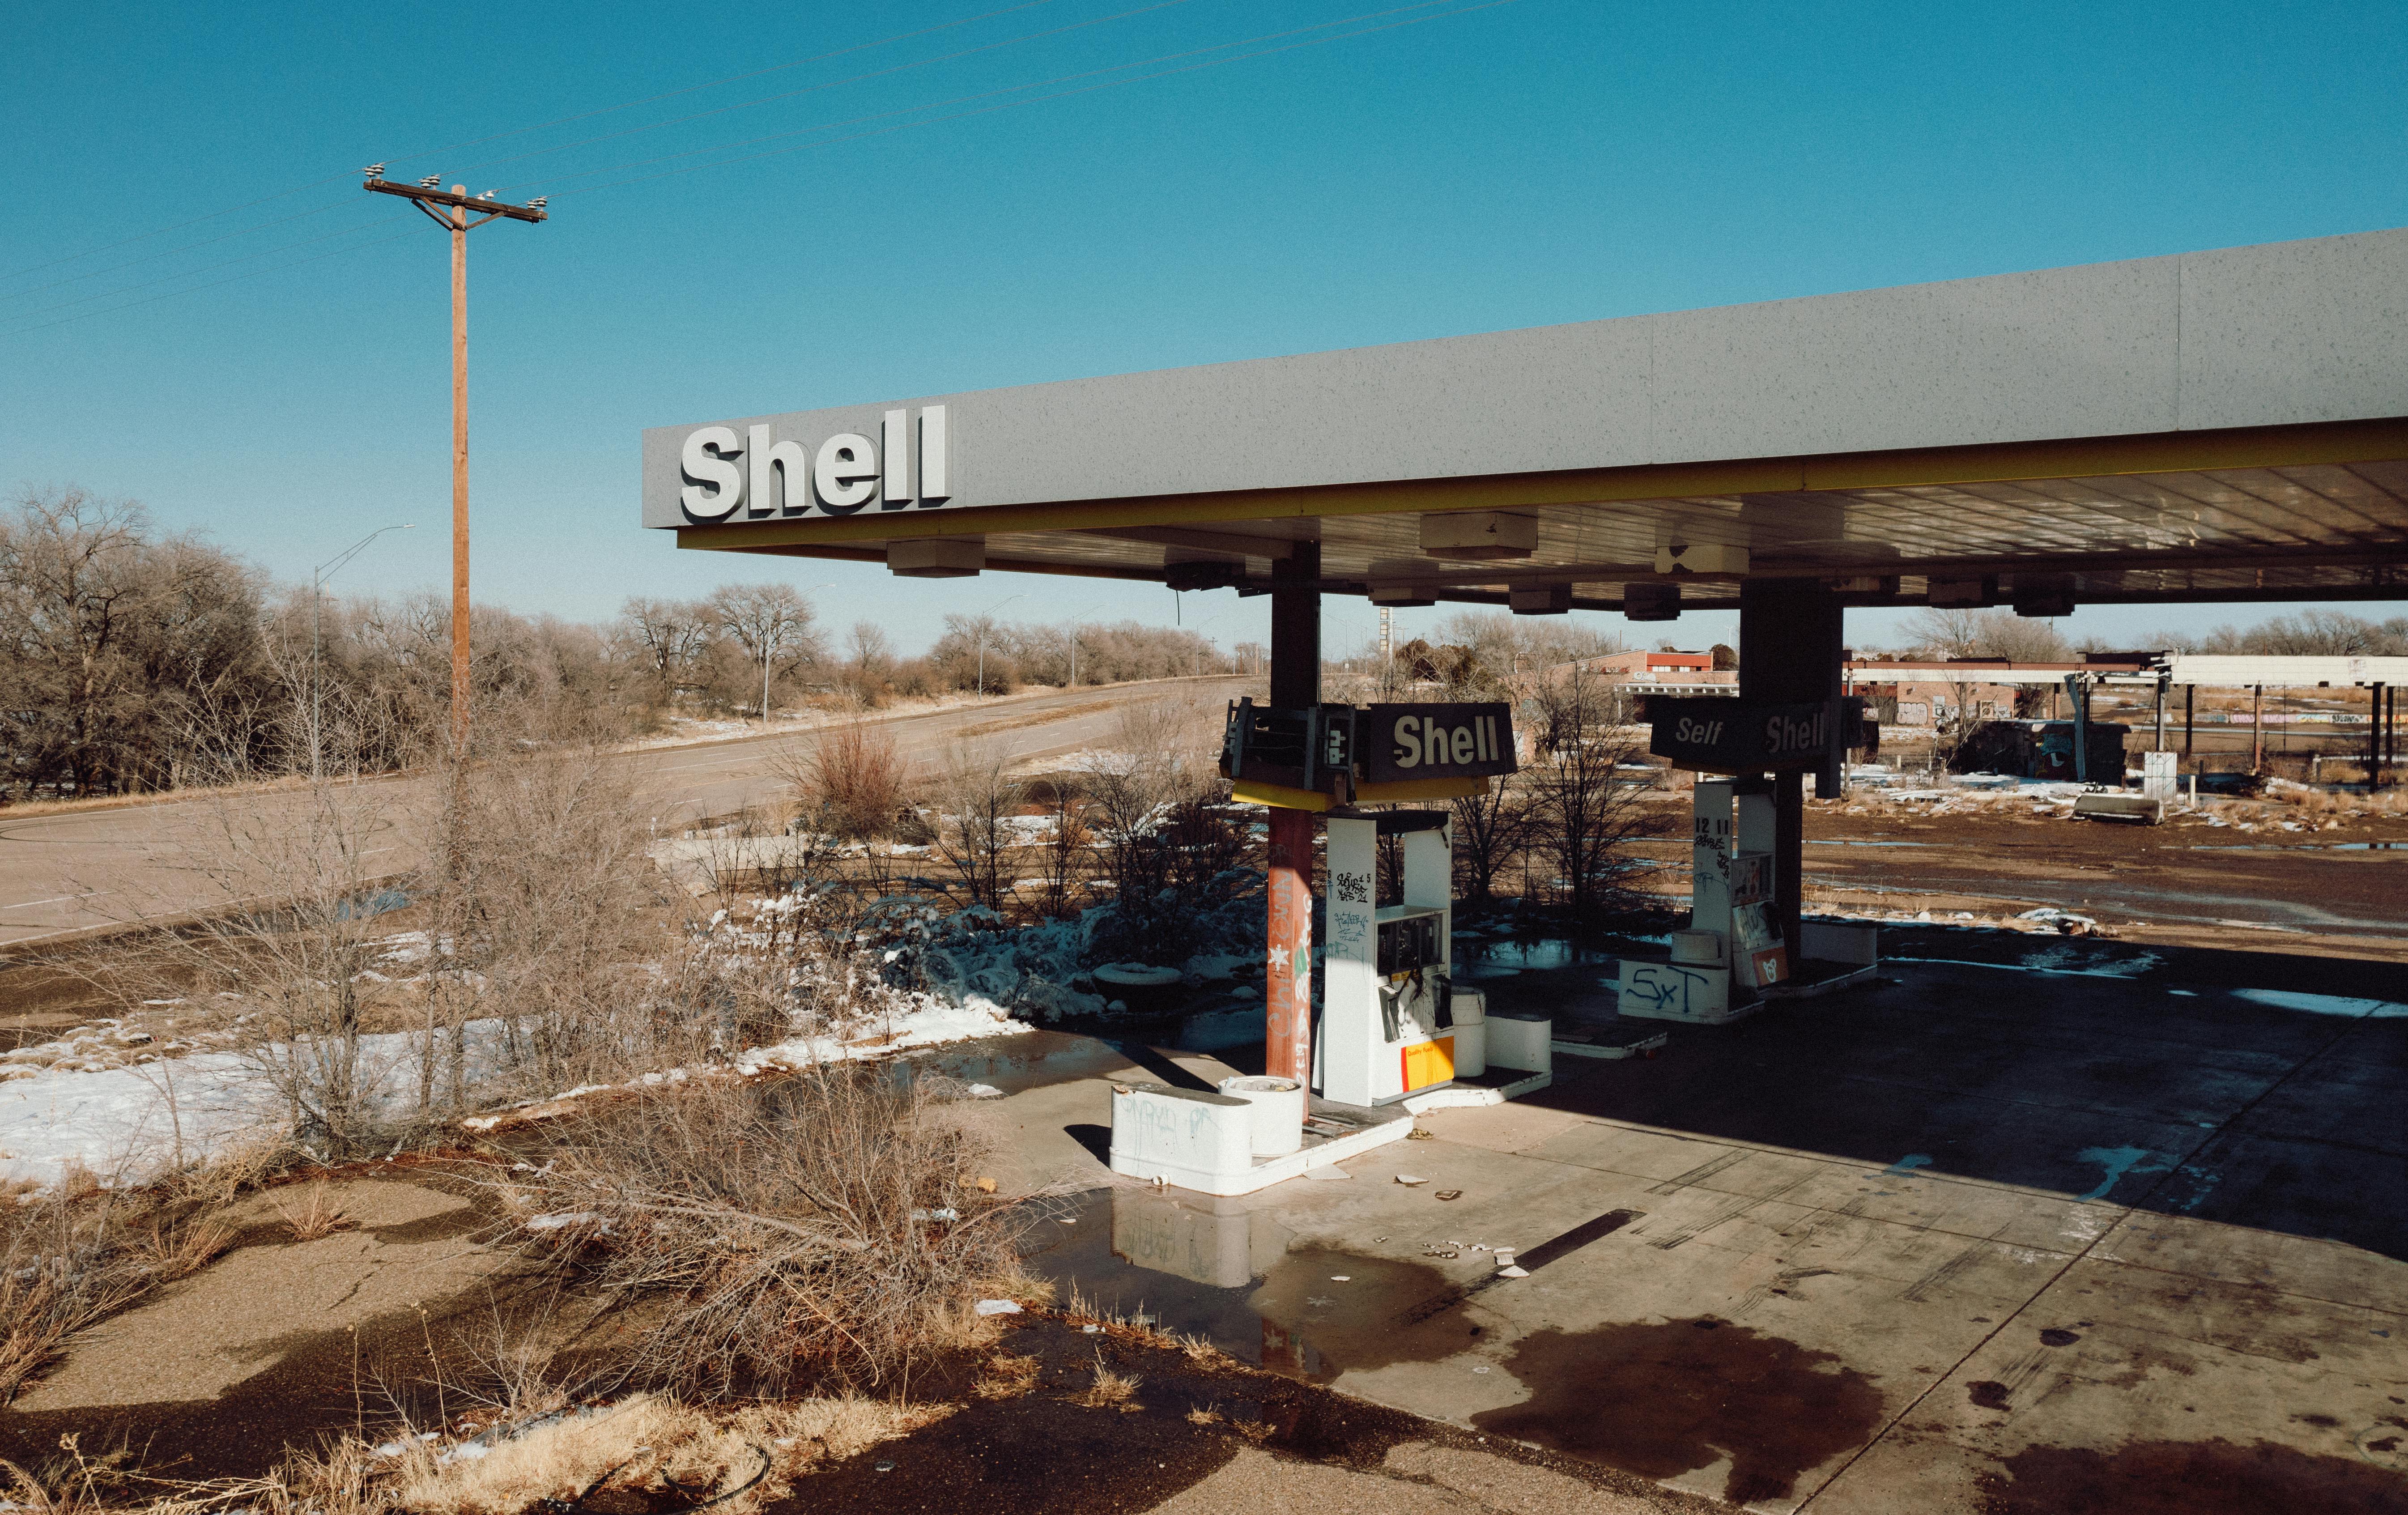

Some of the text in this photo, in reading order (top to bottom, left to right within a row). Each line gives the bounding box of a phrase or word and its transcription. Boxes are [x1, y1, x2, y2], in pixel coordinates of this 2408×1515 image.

[681, 405, 948, 521] Shell
[1394, 715, 1499, 768] Shell
[1676, 717, 1724, 745] Self
[1766, 713, 1824, 754] Shell
[1696, 817, 1710, 834] 12
[1717, 819, 1729, 835] 11
[1327, 869, 1331, 879] 6
[1367, 873, 1370, 883] 5
